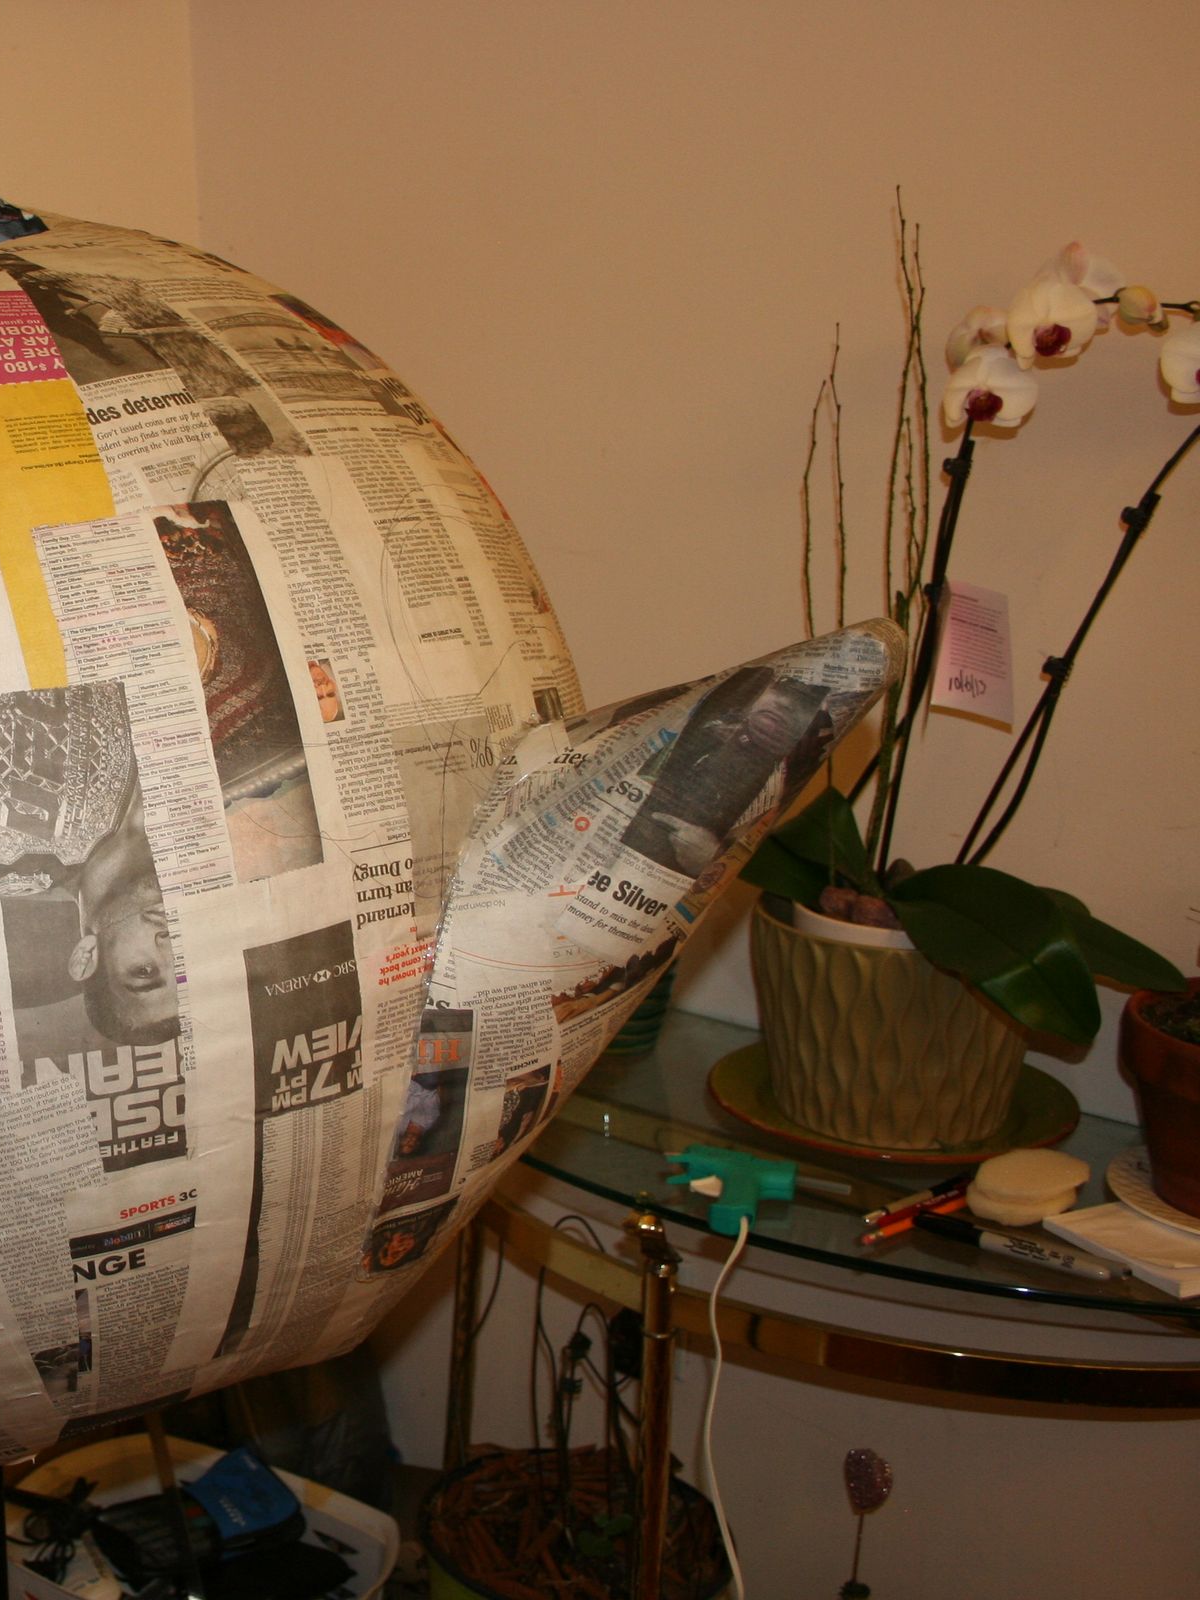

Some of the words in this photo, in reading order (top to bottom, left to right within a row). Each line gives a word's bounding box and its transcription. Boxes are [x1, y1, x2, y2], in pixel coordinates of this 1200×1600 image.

[4, 361, 47, 373] $180
[86, 406, 122, 425] des
[122, 388, 196, 415] determi
[96, 429, 118, 440] Gov't
[120, 422, 144, 434] issued
[145, 419, 164, 428] coins
[180, 414, 189, 422] up
[124, 435, 139, 444] who
[140, 430, 159, 441] finds
[179, 424, 190, 433] zip
[192, 421, 208, 429] code
[106, 454, 116, 464] by
[117, 446, 150, 459] covering
[150, 442, 162, 450] the
[163, 436, 185, 447] Vault
[200, 432, 212, 441] for
[352, 860, 401, 884] Dungy
[356, 884, 392, 904] turn
[396, 881, 413, 894] an
[612, 880, 668, 917] Silver
[567, 905, 595, 924] money
[592, 919, 608, 928] for
[600, 907, 608, 915] to
[610, 912, 627, 924] miss
[386, 947, 410, 963] year's
[401, 956, 421, 968] come
[333, 960, 356, 977] SBC
[380, 963, 399, 976] back
[391, 968, 416, 983] knows
[264, 974, 312, 996] ARENA
[378, 977, 389, 986] he
[275, 1069, 307, 1092] PT
[310, 1062, 341, 1101] 7
[271, 1087, 307, 1111] PM
[99, 1131, 178, 1157] FEATHE
[120, 1195, 176, 1219] SPORTS
[179, 1188, 198, 1201] 3C
[73, 1247, 146, 1283] NGE
